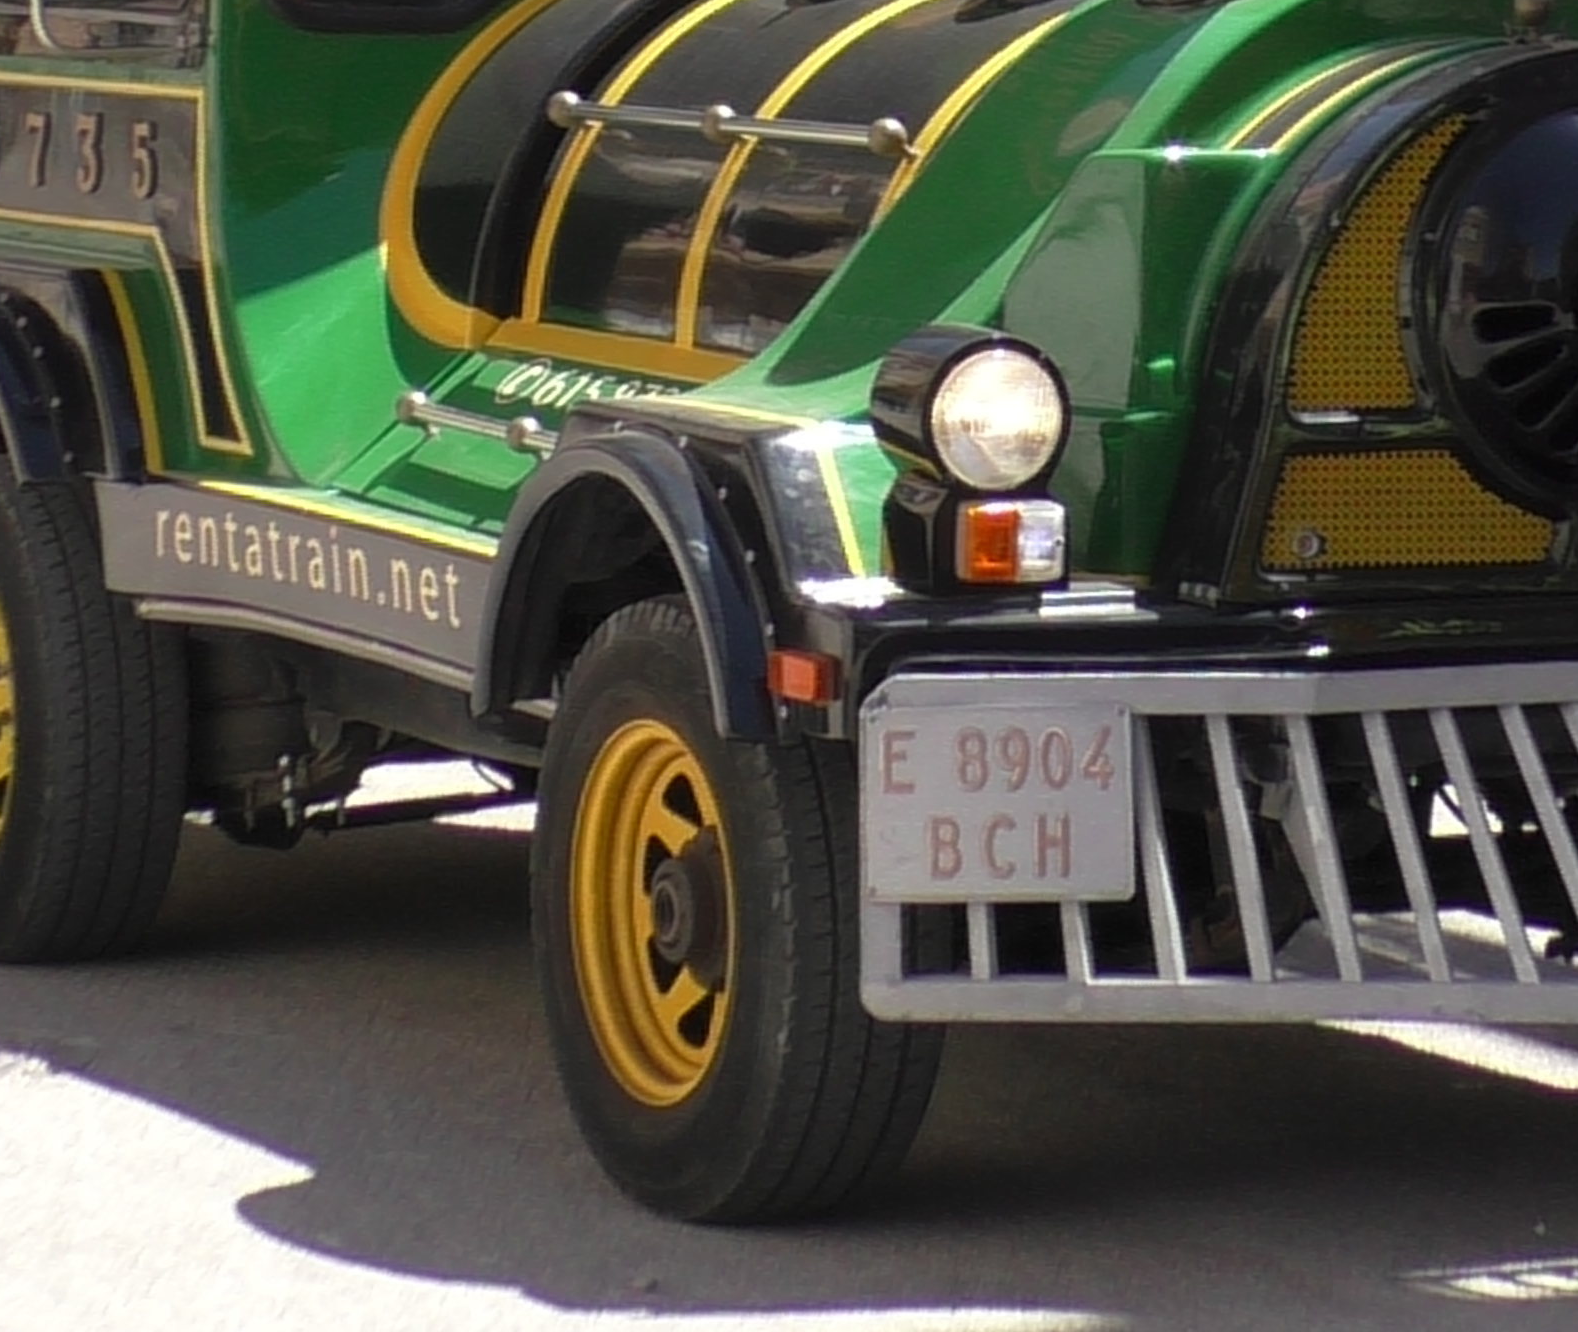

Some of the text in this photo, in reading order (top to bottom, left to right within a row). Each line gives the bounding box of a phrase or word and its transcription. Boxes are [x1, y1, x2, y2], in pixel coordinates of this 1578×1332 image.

[156, 510, 461, 629] rentatrain.net
[880, 725, 1116, 795] E 8904
[928, 812, 1072, 880] BCH
